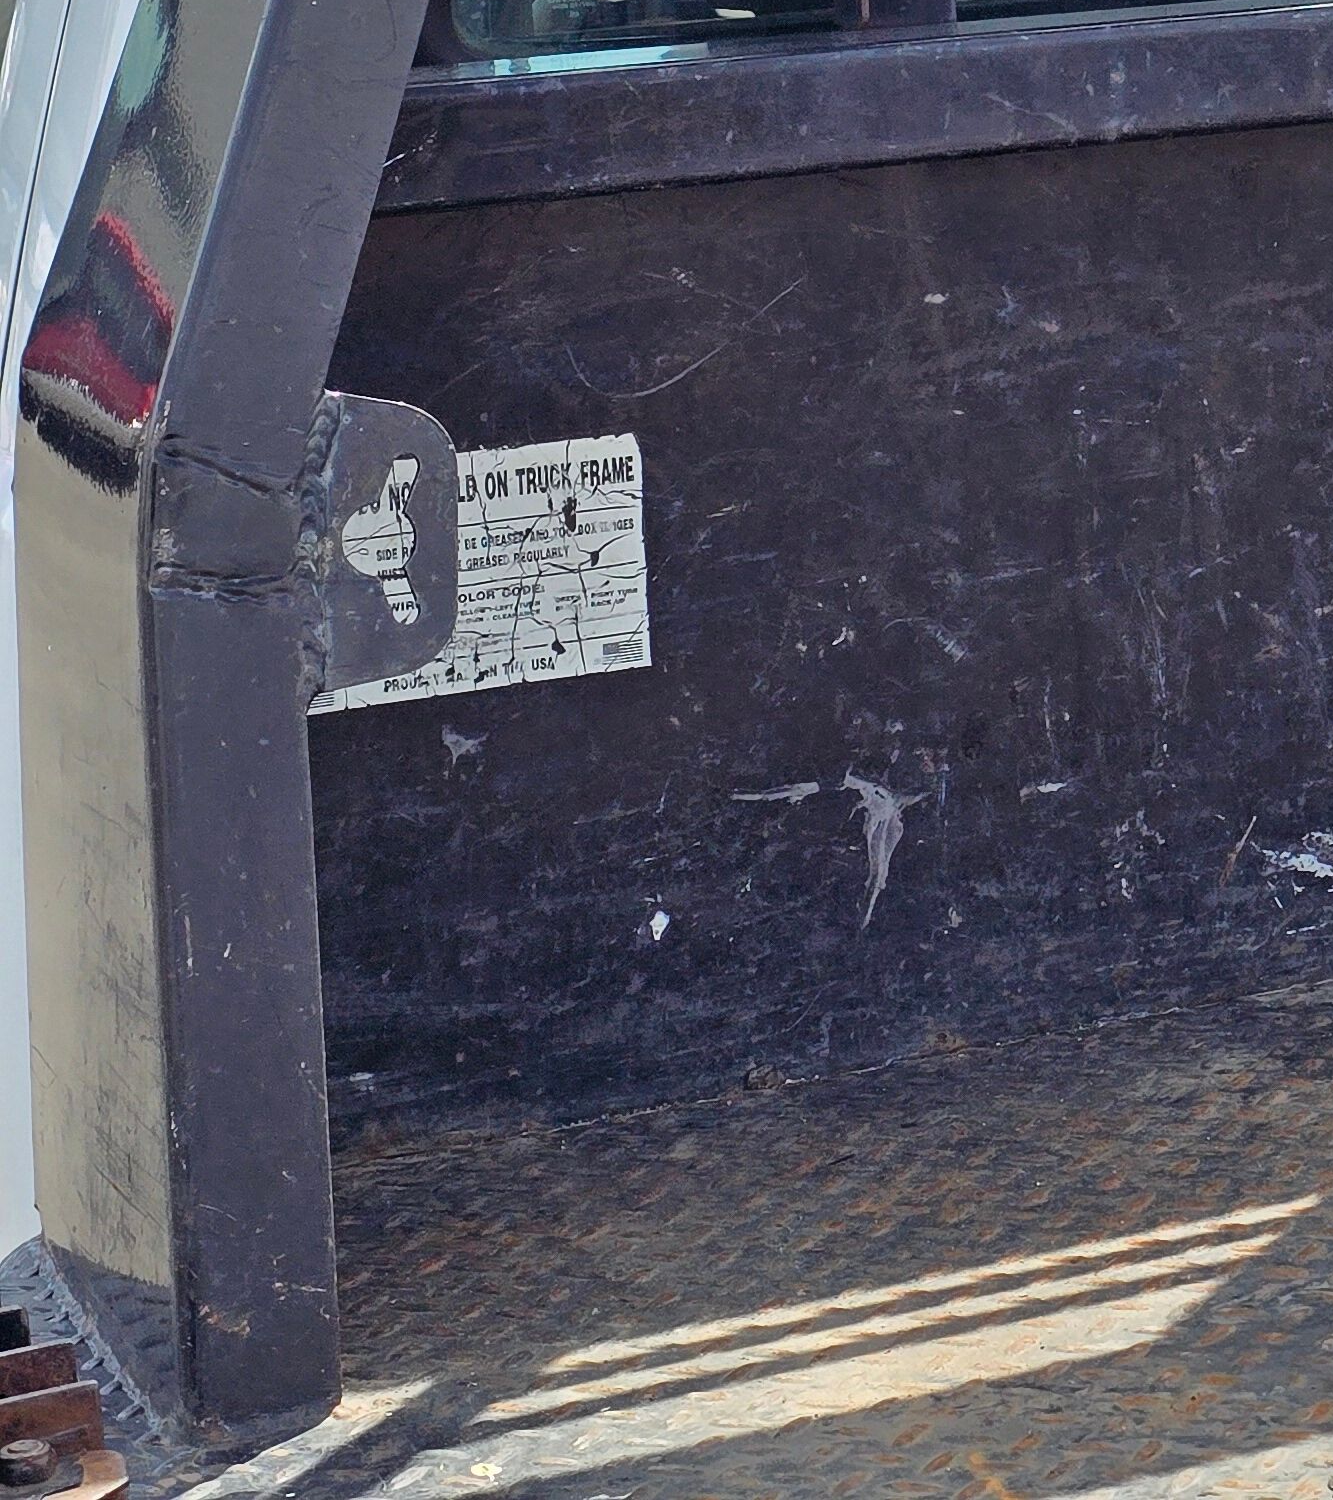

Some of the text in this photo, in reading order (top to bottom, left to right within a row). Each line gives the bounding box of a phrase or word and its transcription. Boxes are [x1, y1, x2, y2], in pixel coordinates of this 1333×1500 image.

[485, 470, 508, 500] ON
[515, 463, 572, 496] TRUCK
[580, 456, 635, 486] FRAME
[376, 549, 398, 562] SIDE
[466, 554, 509, 570] GREASED
[531, 657, 556, 671] USA
